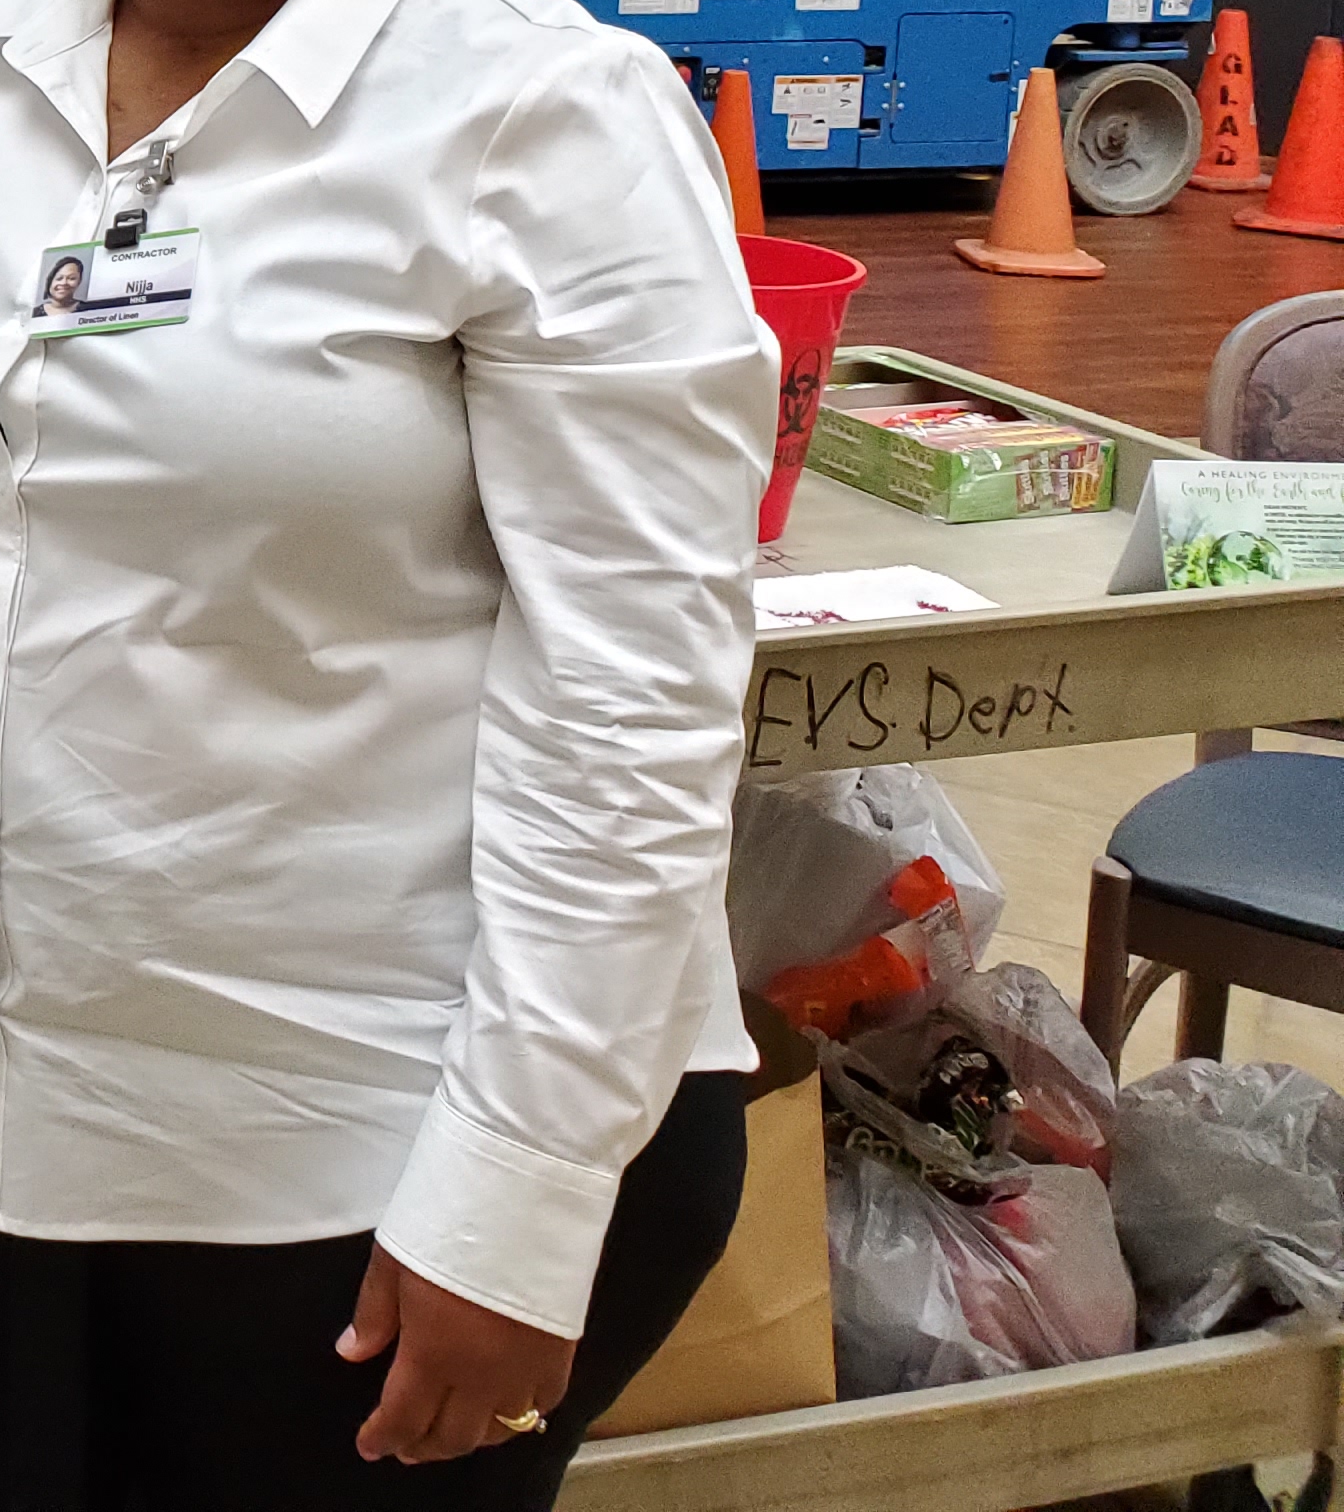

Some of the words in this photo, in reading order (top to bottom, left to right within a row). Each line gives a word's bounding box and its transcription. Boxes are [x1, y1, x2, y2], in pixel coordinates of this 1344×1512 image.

[111, 247, 178, 263] CONTRACTOR
[125, 280, 154, 295] Nijja
[77, 315, 107, 325] Director
[108, 313, 117, 322] of
[118, 311, 139, 321] Linen
[1198, 470, 1206, 479] A
[1212, 470, 1267, 479] HEALING
